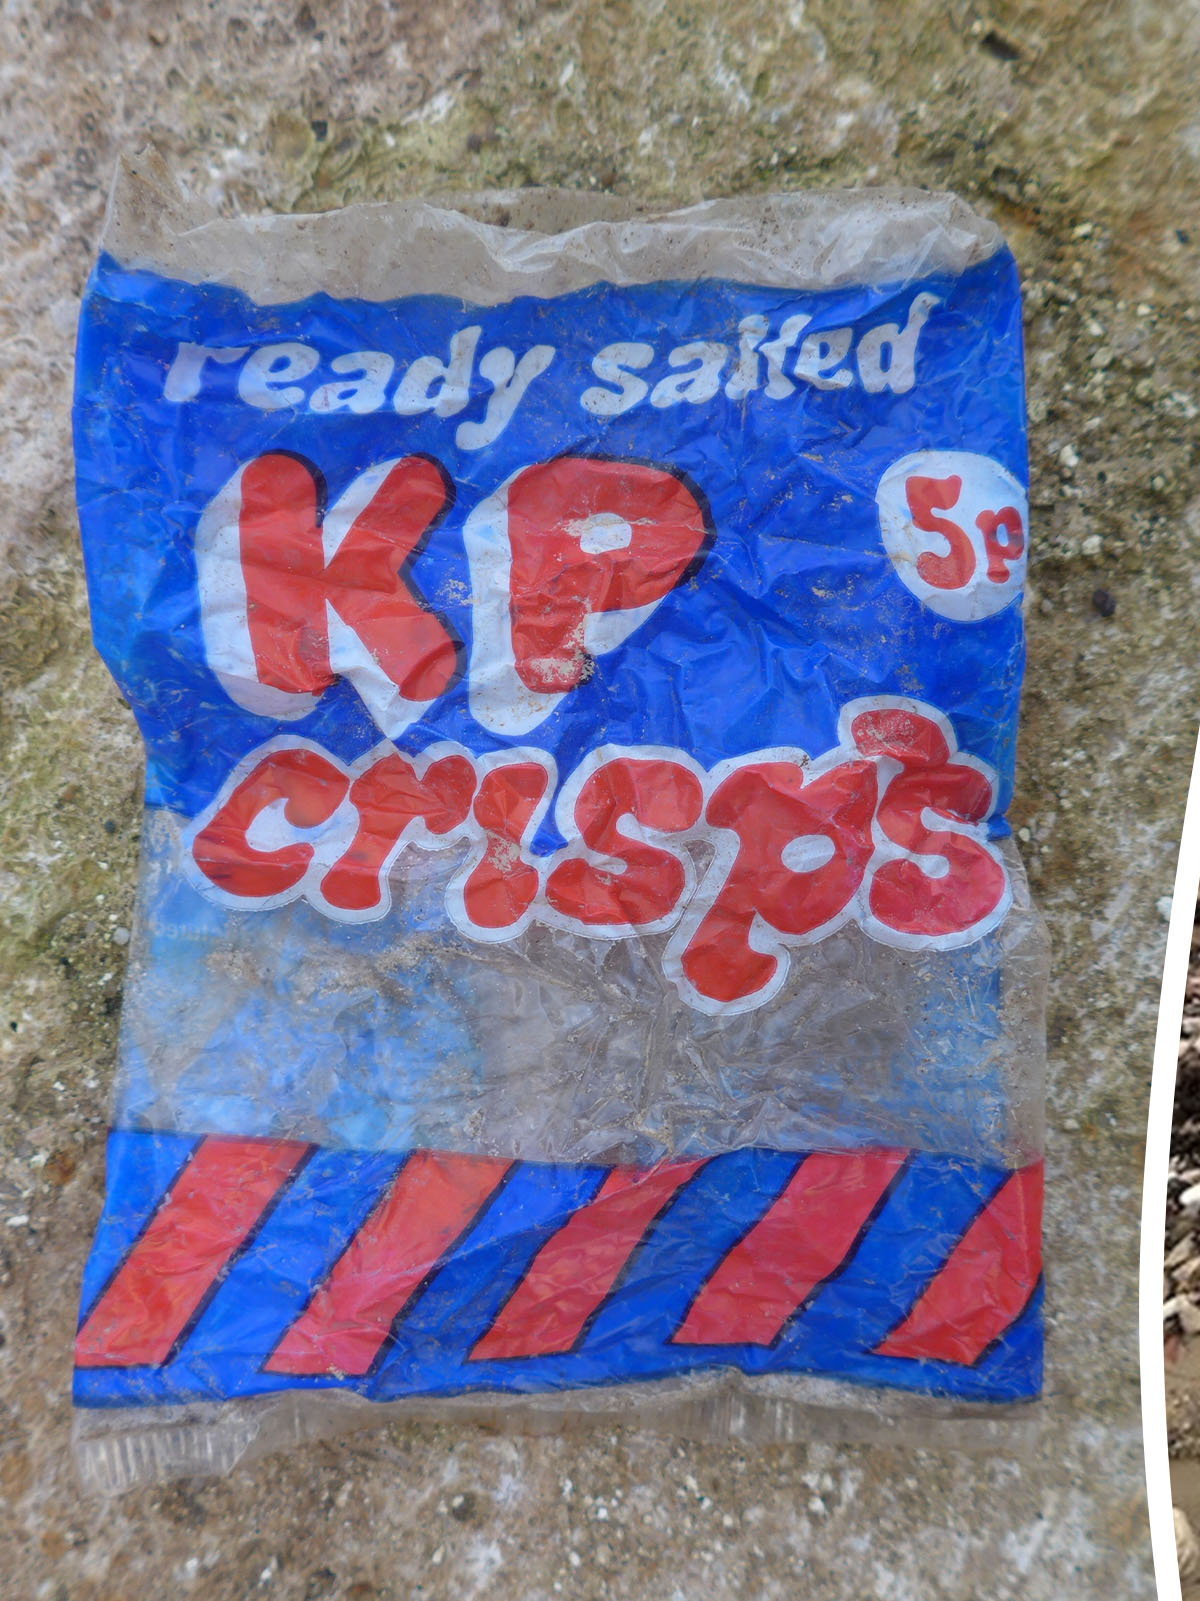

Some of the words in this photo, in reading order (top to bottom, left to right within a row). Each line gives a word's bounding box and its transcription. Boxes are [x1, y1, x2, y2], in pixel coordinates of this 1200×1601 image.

[161, 325, 558, 452] ready
[578, 293, 941, 417] salted
[195, 451, 716, 738] KP
[904, 474, 1025, 591] 5p
[182, 695, 1013, 1016] crisps
